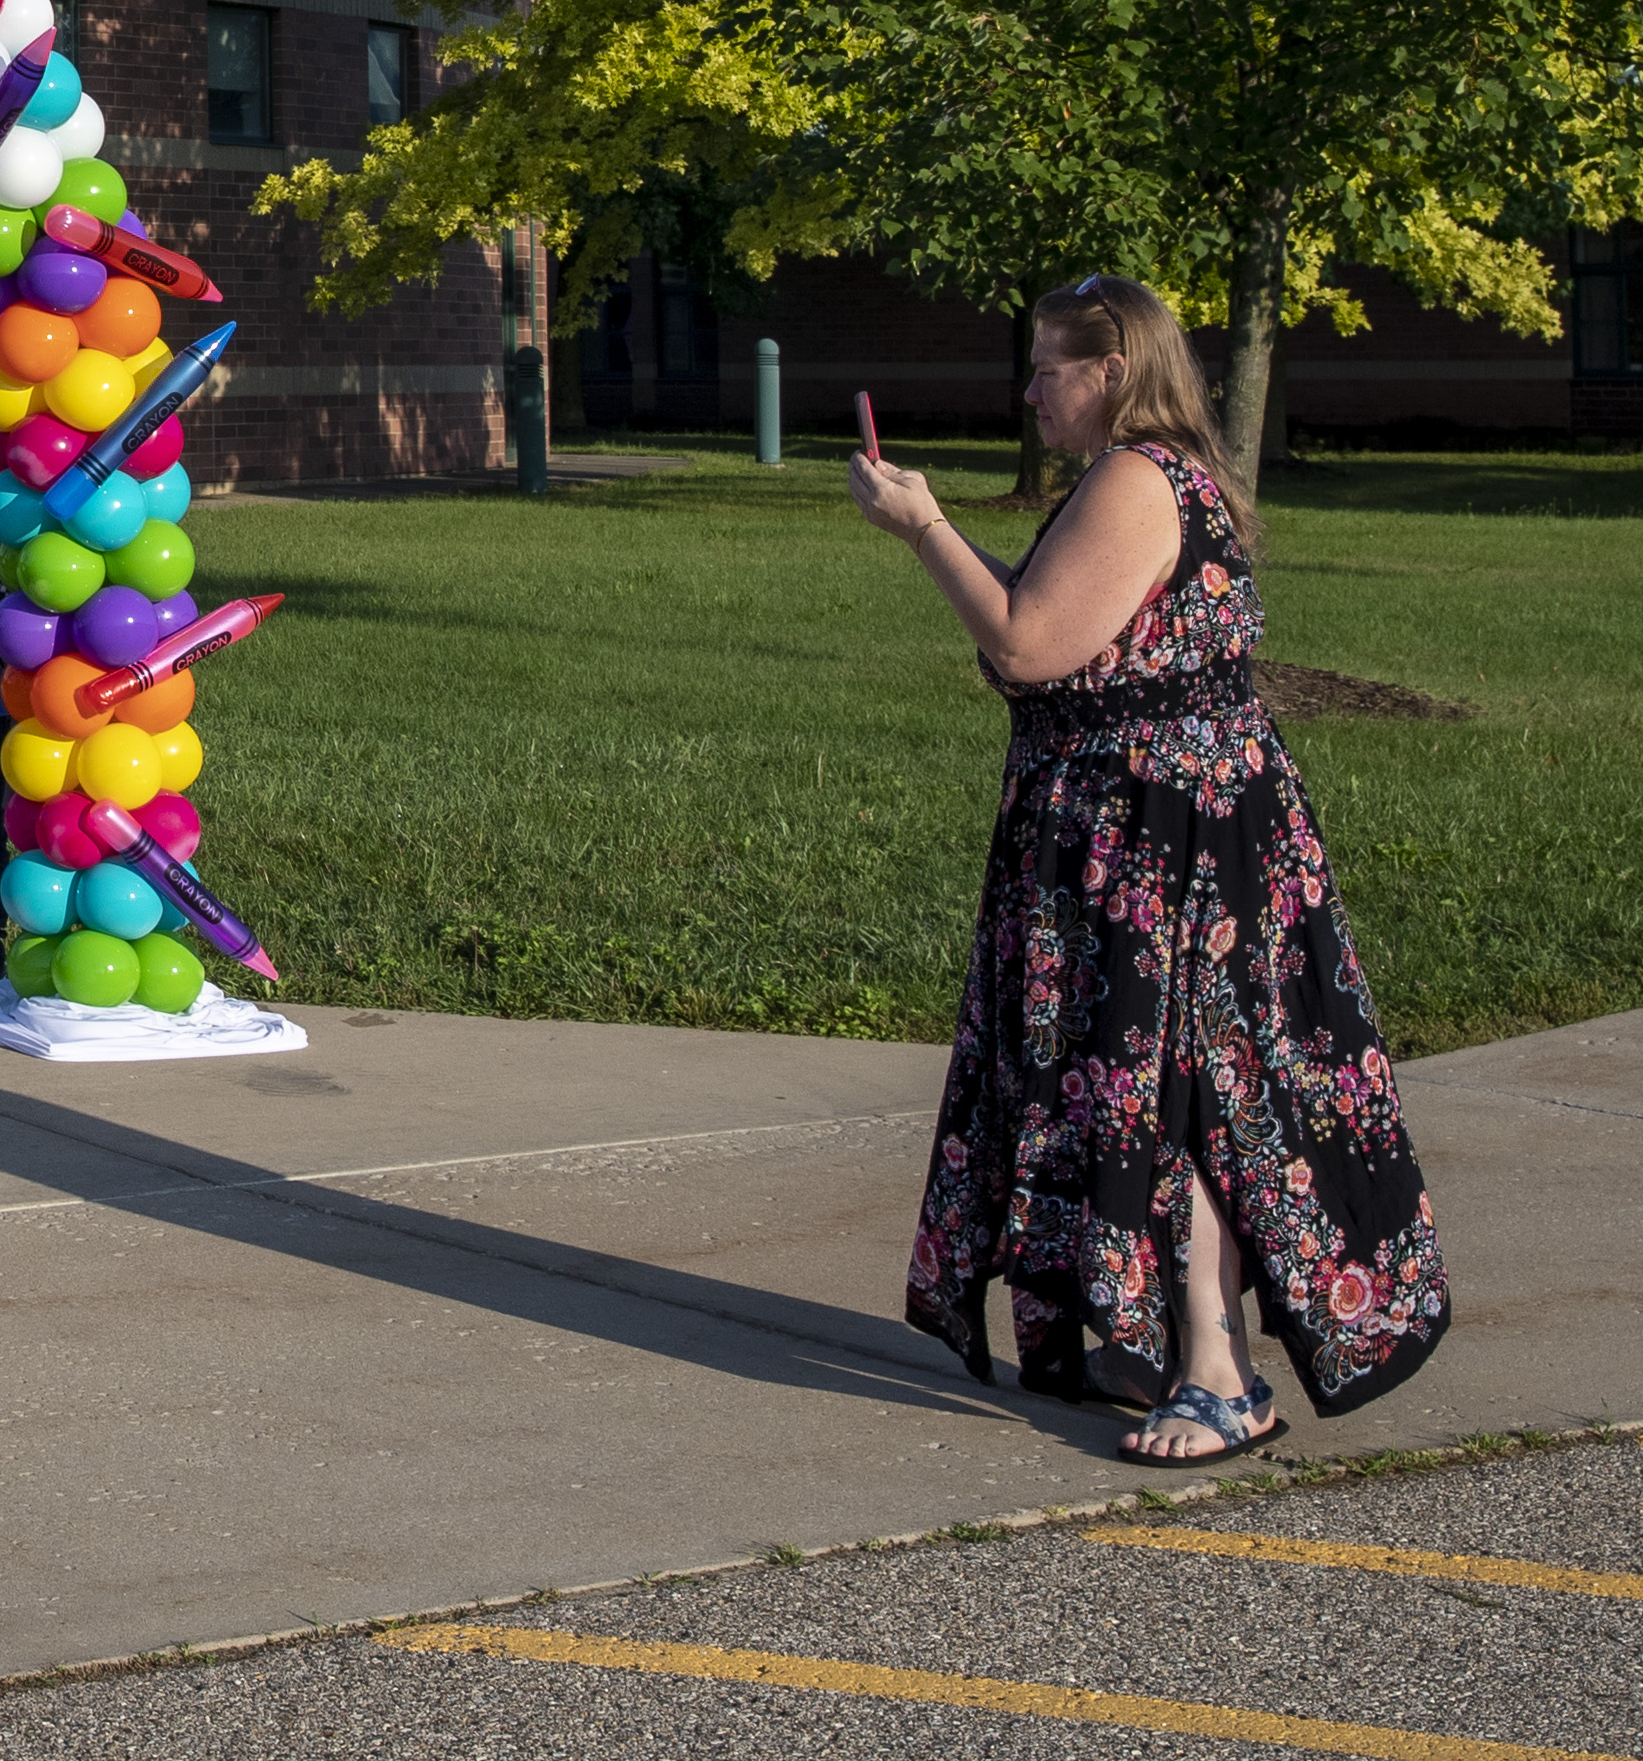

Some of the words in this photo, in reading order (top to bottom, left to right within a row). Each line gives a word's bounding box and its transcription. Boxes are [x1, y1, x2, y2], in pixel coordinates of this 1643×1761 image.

[128, 253, 176, 284] CRAYON
[127, 396, 180, 449] CRAYON
[176, 634, 228, 671] CRAYON
[169, 868, 220, 920] CRAYON
